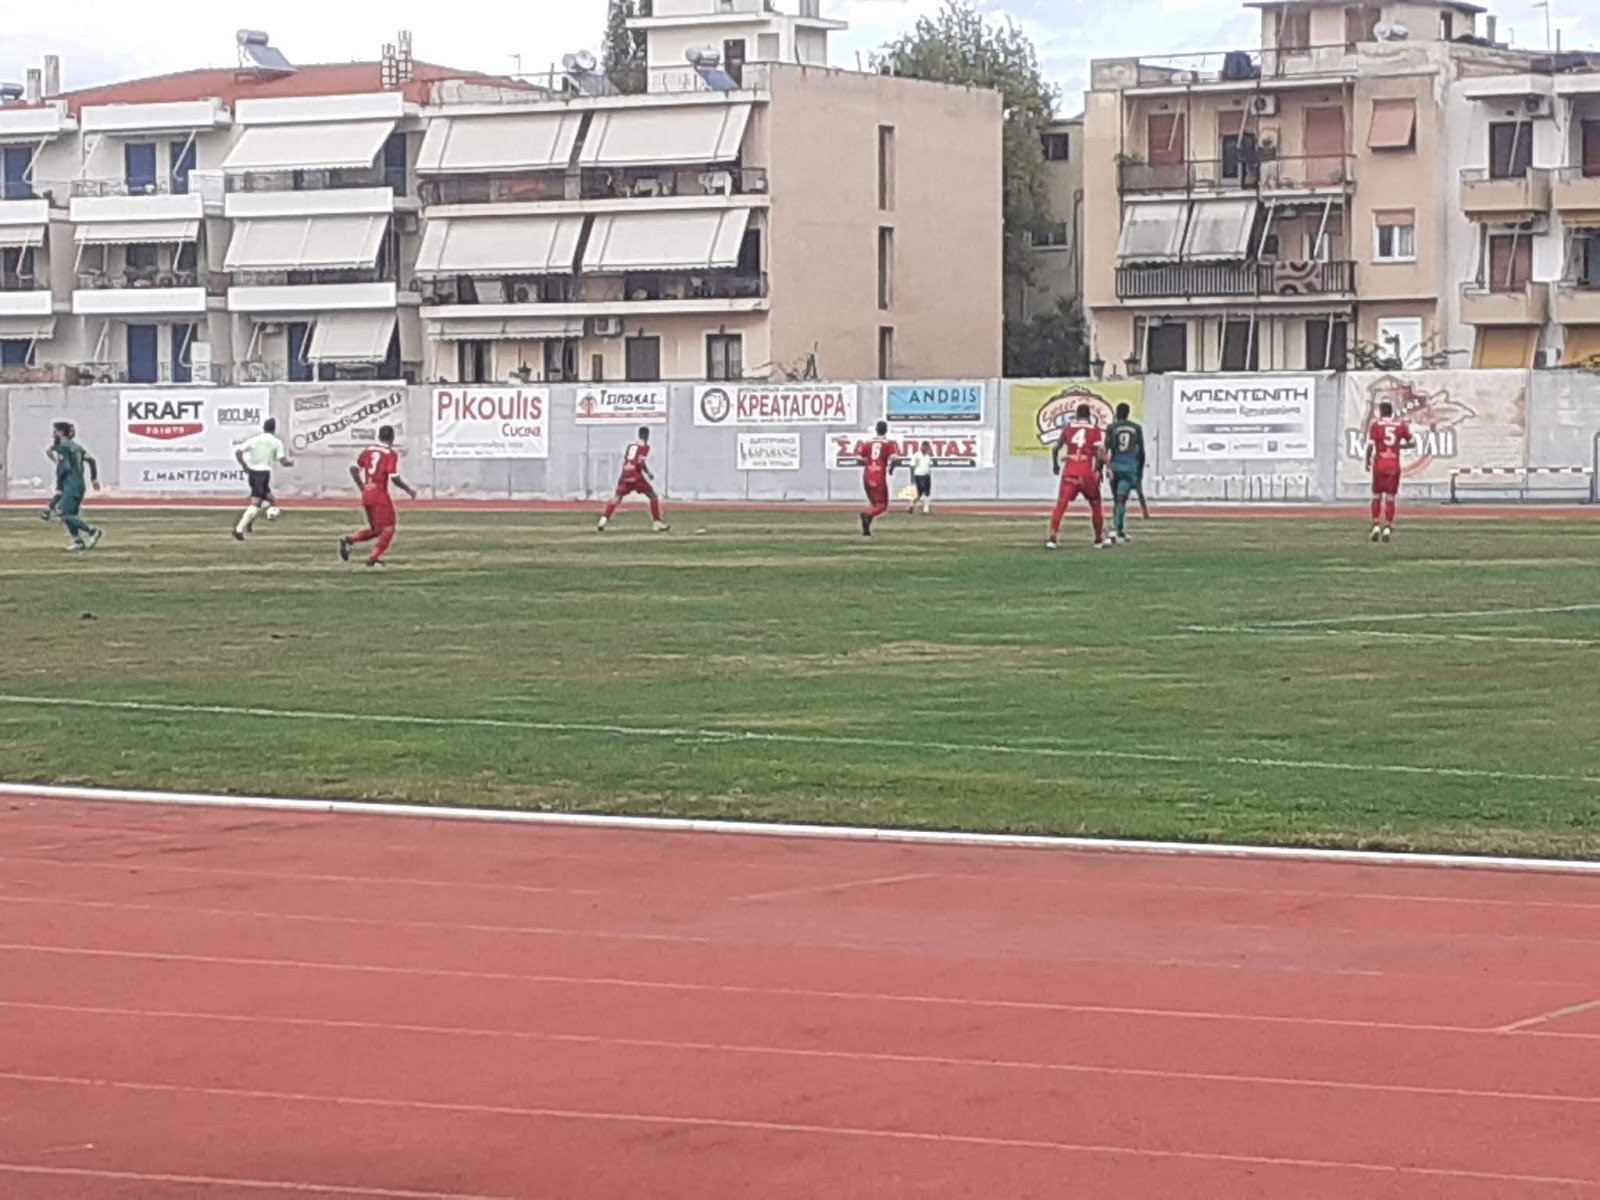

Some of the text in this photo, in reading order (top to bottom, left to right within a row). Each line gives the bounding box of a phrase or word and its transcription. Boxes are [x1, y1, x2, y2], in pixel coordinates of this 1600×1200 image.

[437, 390, 543, 421] Pikoulis
[737, 394, 846, 417] ΚΡΕΑΤΑΓΟΡΑ
[909, 388, 977, 403] ANDRIS
[127, 401, 204, 420] KRAFT
[1071, 428, 1087, 448] 4
[1118, 432, 1130, 452] 9
[1383, 426, 1396, 446] 5
[871, 442, 882, 460] 6
[367, 451, 380, 475] 3
